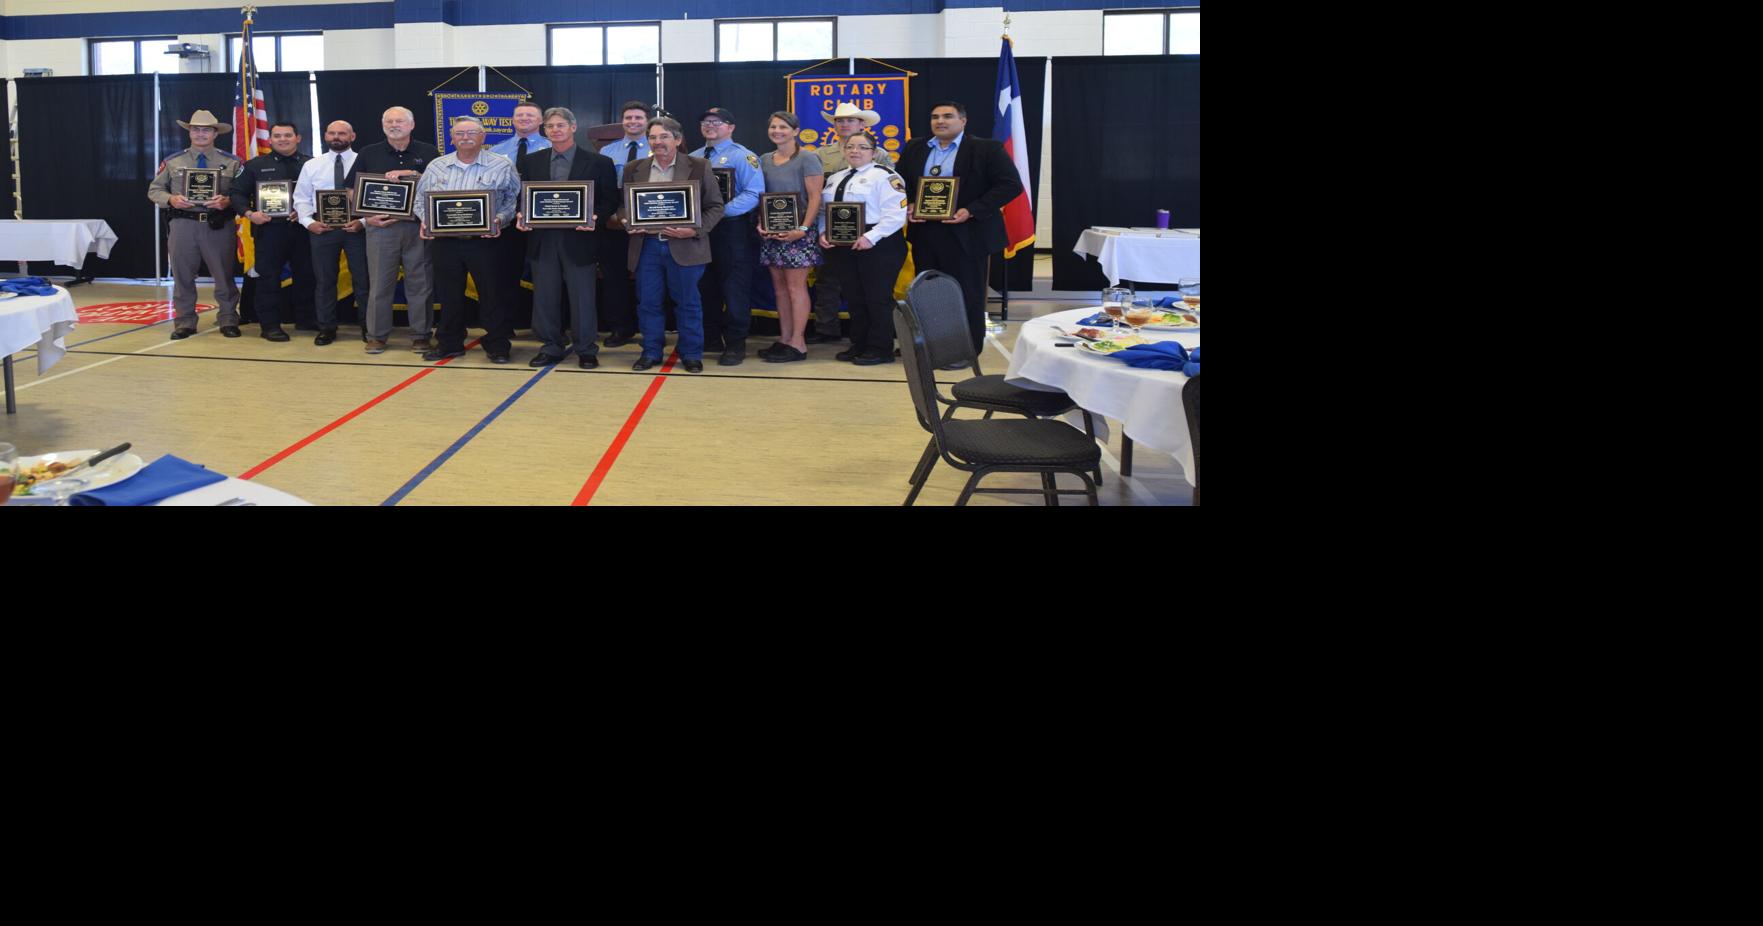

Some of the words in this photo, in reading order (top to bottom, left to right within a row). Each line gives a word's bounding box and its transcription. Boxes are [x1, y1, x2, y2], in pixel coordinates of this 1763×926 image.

[810, 83, 887, 96] ROTARY
[483, 117, 498, 126] WAY
[499, 117, 512, 126] TEST
